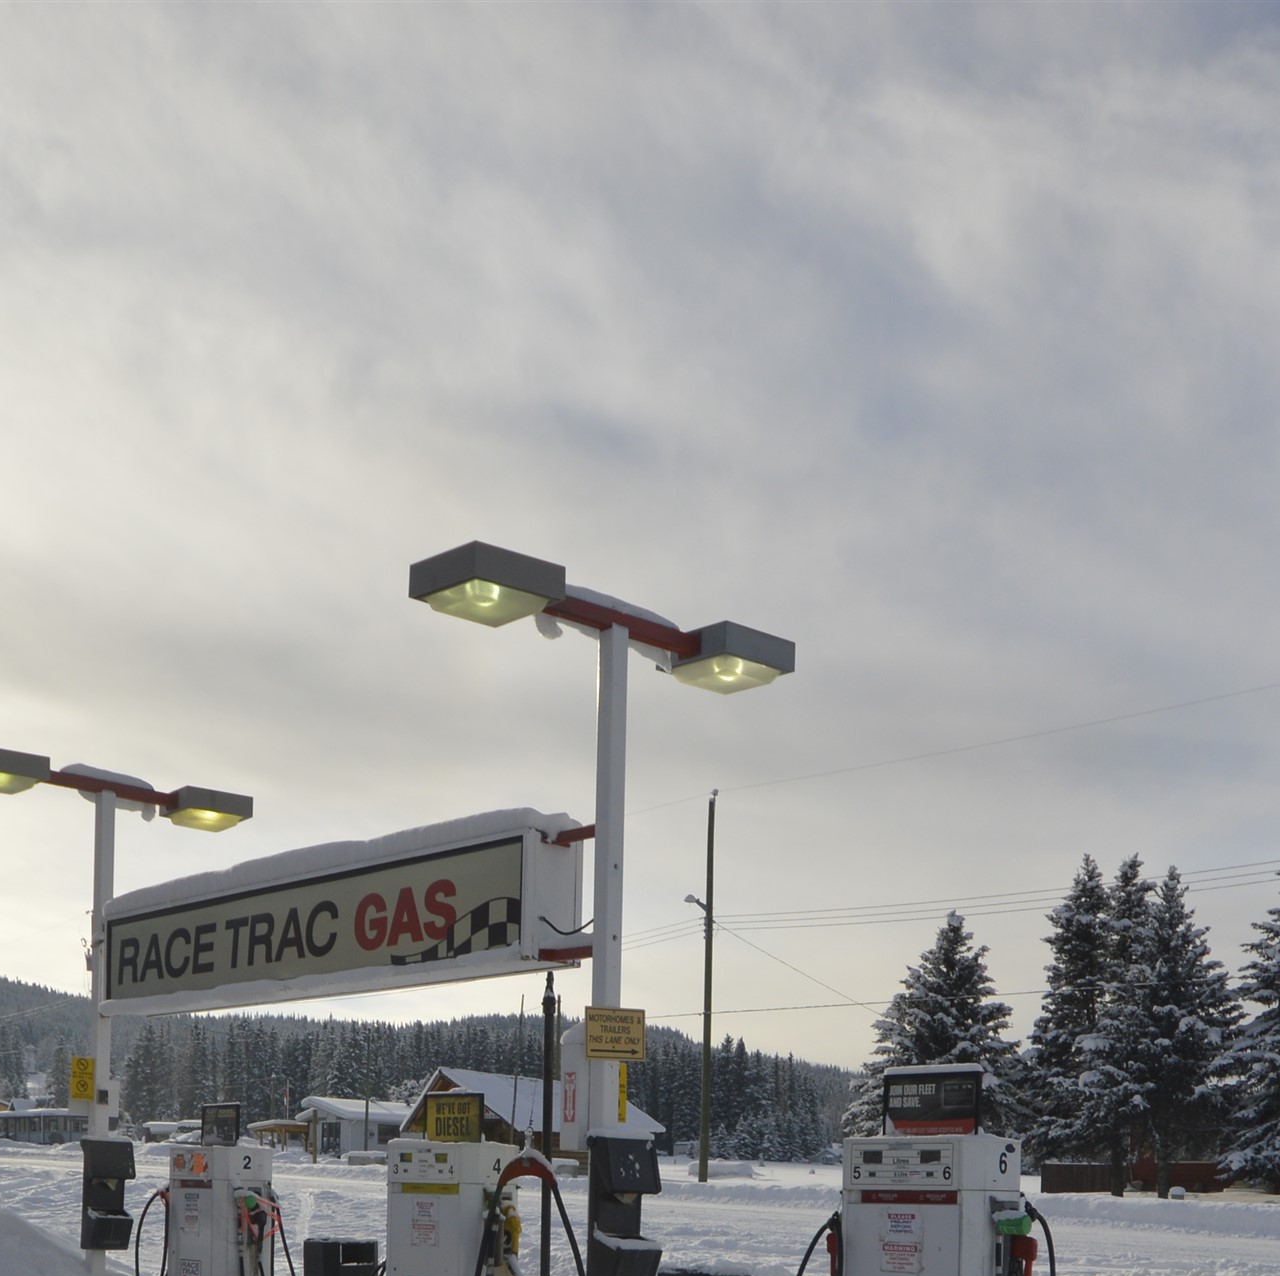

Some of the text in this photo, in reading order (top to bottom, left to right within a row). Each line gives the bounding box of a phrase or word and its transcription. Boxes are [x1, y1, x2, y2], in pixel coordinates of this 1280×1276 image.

[118, 879, 457, 985] RACE TRAC GAS
[588, 1014, 642, 1025] MOTORHOMES &
[600, 1025, 631, 1035] TRAILERS
[589, 1035, 640, 1045] THIS LANE ONLY
[890, 1084, 903, 1096] JOIN
[903, 1084, 917, 1095] OUR
[918, 1083, 936, 1095] FLEET
[435, 1102, 455, 1115] WE'VE
[457, 1102, 471, 1115] GOT
[889, 1096, 902, 1108] AND
[435, 1116, 472, 1137] DIESEL
[242, 1155, 252, 1170] 2
[492, 1158, 501, 1175] 4
[999, 1152, 1008, 1174] 6
[393, 1164, 399, 1175] 3
[448, 1165, 454, 1176] 4
[852, 1166, 861, 1180] 5
[942, 1166, 951, 1180] 6
[182, 1261, 199, 1269] RACE
[182, 1268, 199, 1276] TRAC
